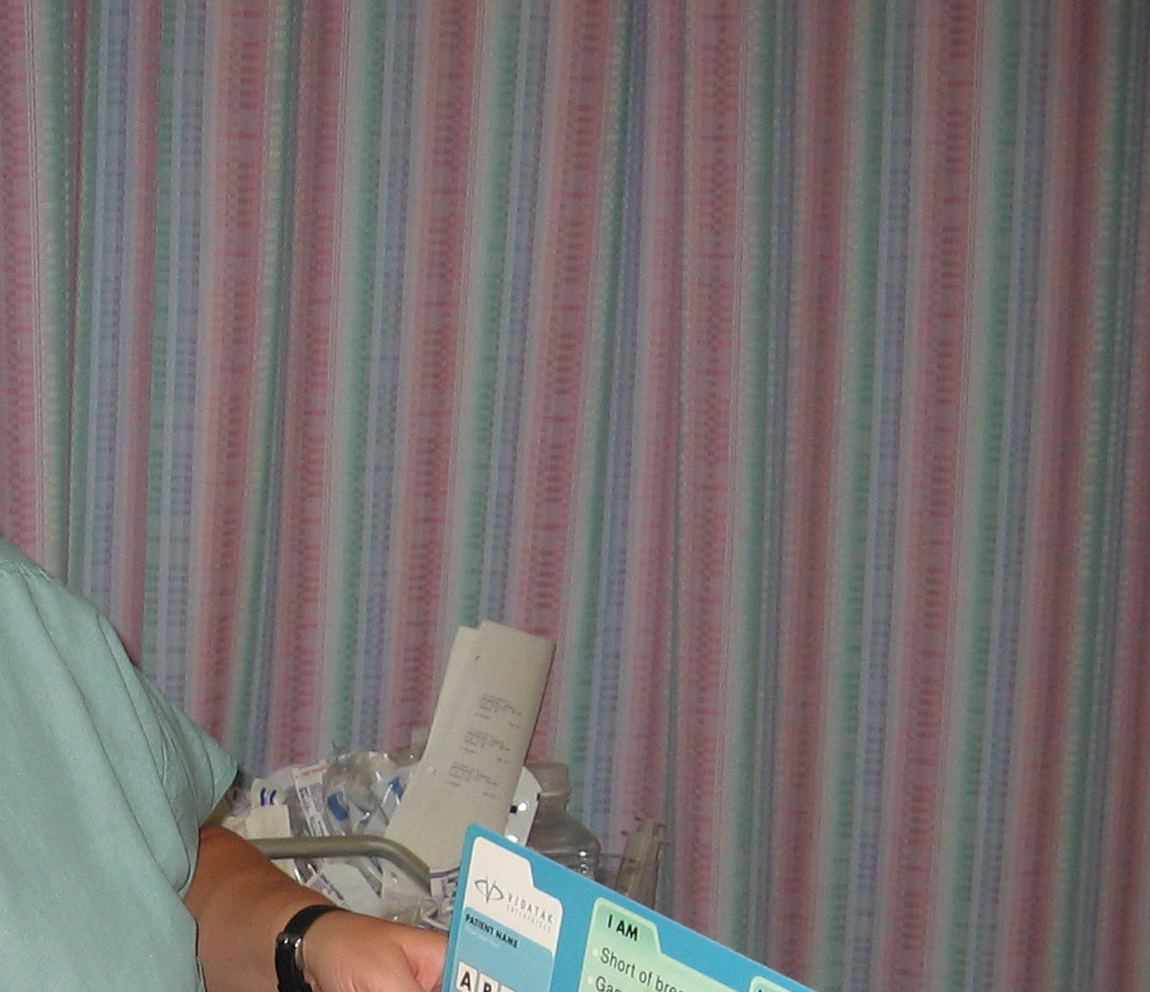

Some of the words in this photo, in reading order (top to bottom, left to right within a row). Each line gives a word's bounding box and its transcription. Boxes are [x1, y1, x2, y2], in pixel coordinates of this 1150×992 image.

[507, 893, 553, 924] VIDATAK
[465, 912, 495, 935] PATIENT
[495, 929, 518, 949] NAME
[607, 913, 614, 929] I
[616, 919, 638, 941] AM
[460, 971, 472, 992] A
[600, 947, 636, 978] Short
[638, 971, 653, 987] of
